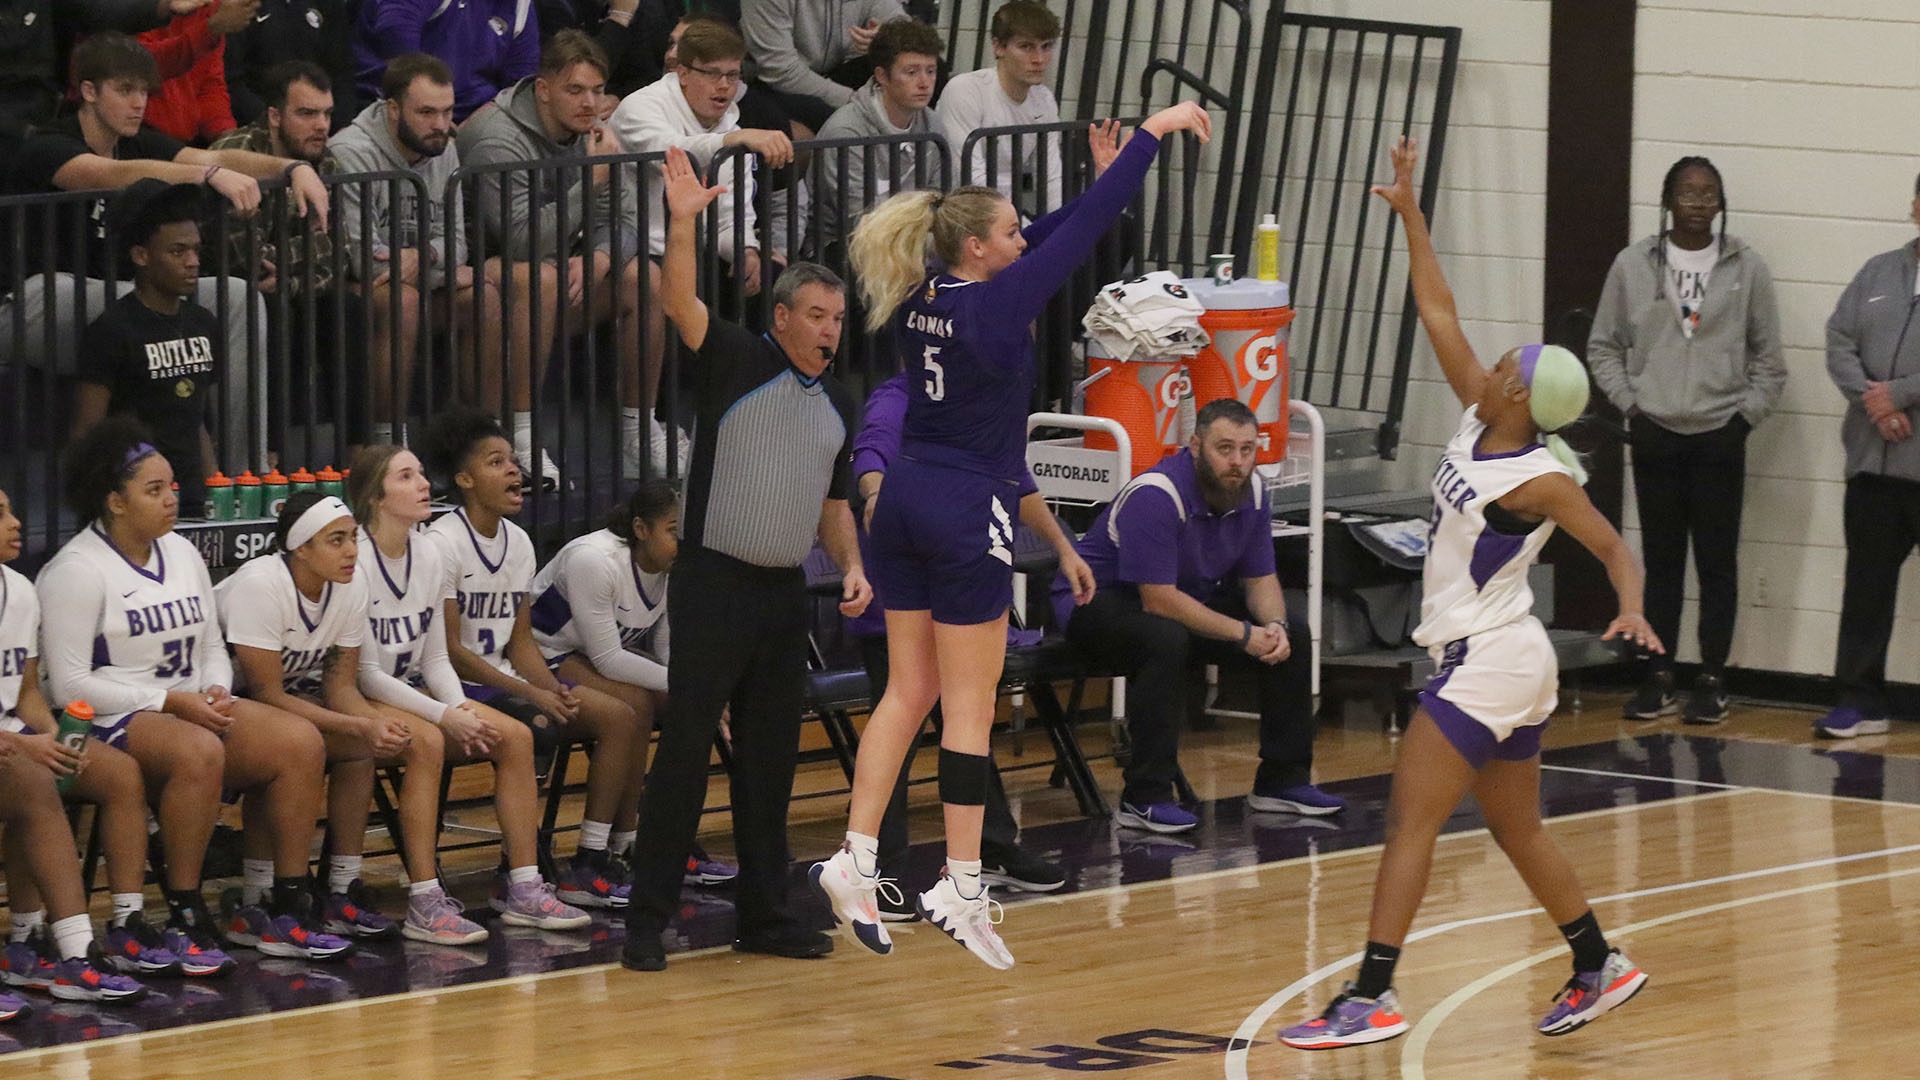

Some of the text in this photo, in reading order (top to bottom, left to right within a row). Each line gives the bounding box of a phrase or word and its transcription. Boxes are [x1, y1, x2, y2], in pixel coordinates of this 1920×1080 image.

[144, 335, 214, 371] BUTLER
[923, 344, 945, 401] 5
[1244, 336, 1278, 381] G
[1033, 462, 1110, 483] GATORADE
[154, 635, 196, 678] 31
